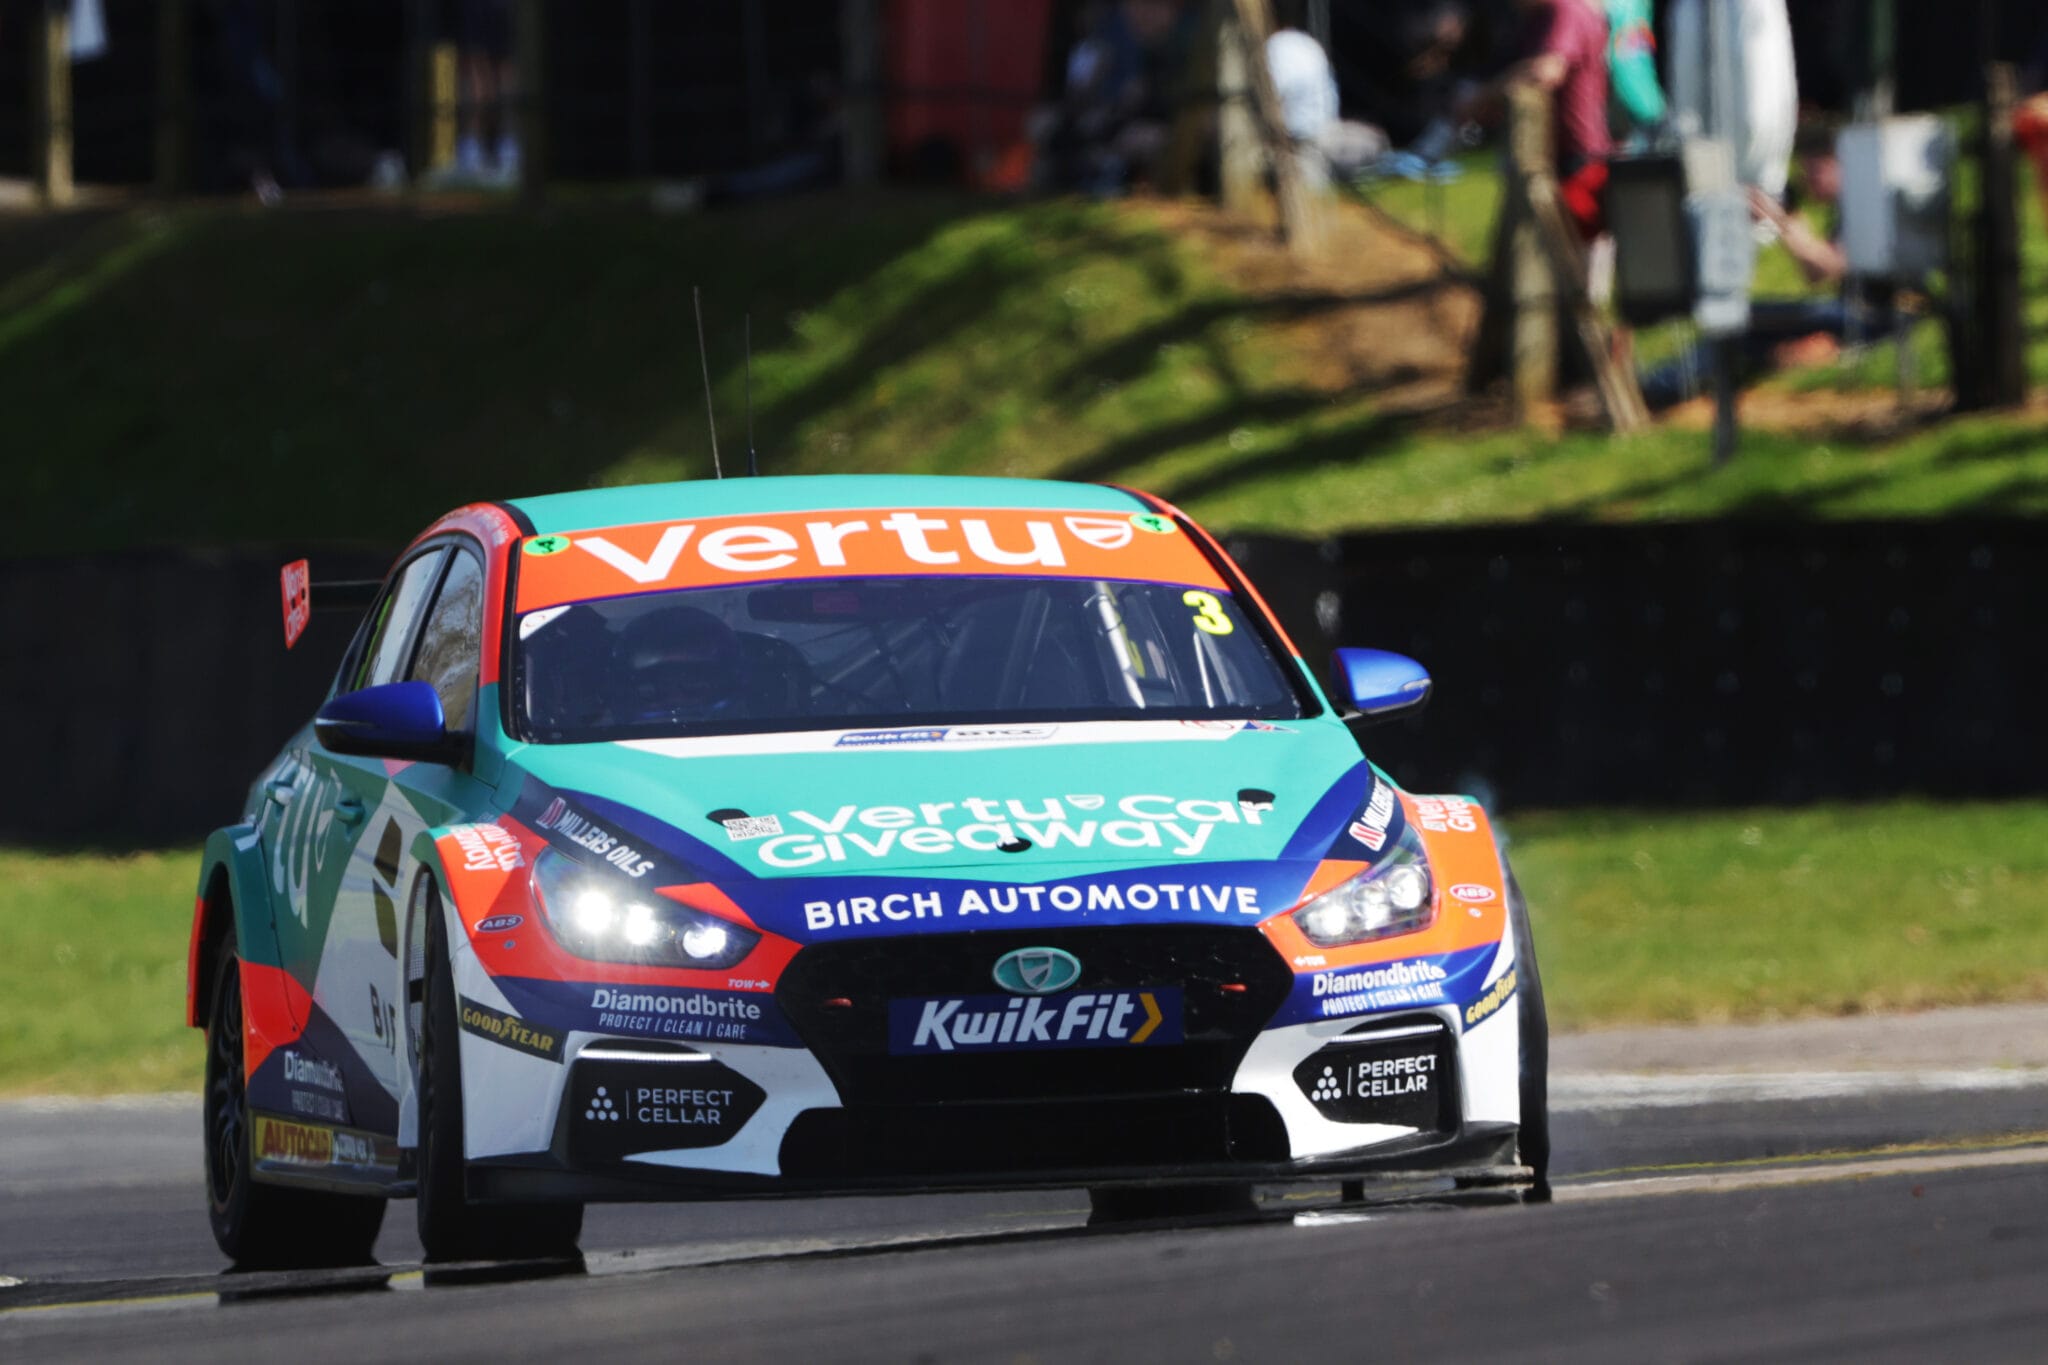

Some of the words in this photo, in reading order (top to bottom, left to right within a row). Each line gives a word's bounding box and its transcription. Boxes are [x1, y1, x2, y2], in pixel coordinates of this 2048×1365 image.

[1183, 590, 1234, 635] 3
[552, 808, 613, 854] MILLERS
[606, 844, 655, 878] OILS
[804, 890, 943, 930] BIRCH
[958, 882, 1261, 916] AUTOMOTIVE
[482, 916, 517, 929] ABS
[727, 978, 754, 990] TOW
[1312, 959, 1447, 997] Diamondbrite
[591, 988, 761, 1020] Diamondbrite
[463, 1007, 554, 1051] GOODYEAR
[599, 1012, 652, 1031] PROTECT
[663, 1018, 702, 1036] CLEAN
[716, 1022, 746, 1040] CARE
[1358, 1054, 1438, 1079] PERFECT
[637, 1088, 733, 1107] PERFECT
[1357, 1075, 1428, 1098] CELLAR
[637, 1107, 721, 1125] CELLAR
